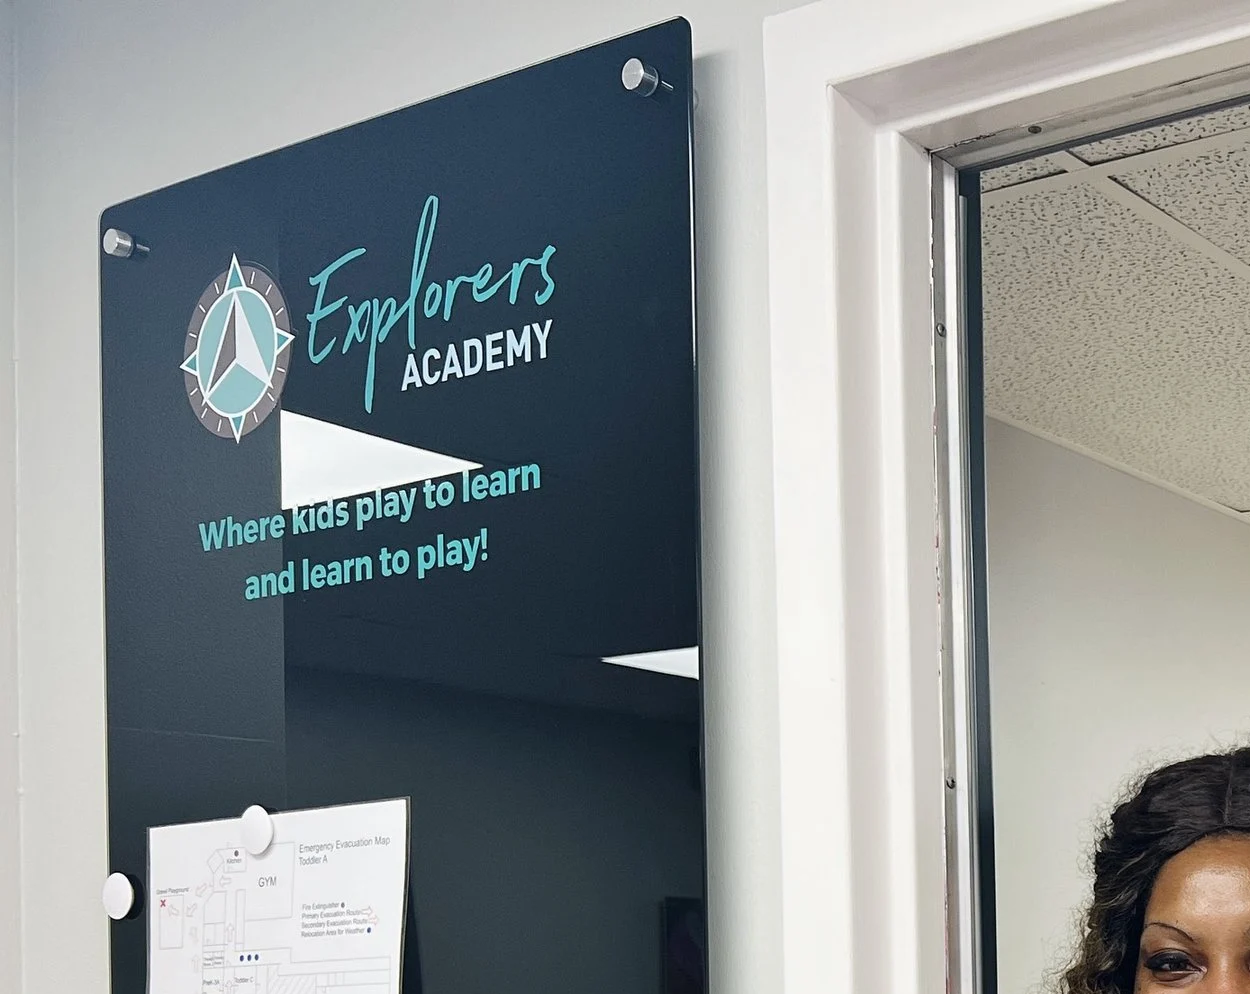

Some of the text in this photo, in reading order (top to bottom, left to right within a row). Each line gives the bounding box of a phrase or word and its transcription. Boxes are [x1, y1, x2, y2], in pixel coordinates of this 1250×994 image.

[306, 195, 558, 414] Explorers
[401, 319, 553, 391] ACADEMY
[199, 462, 541, 551] Where kids play to learn
[245, 527, 489, 601] and learn to play!
[299, 836, 391, 854] Emergency Evacuation Map
[299, 854, 328, 866] Toddler A
[258, 876, 277, 888] GYM
